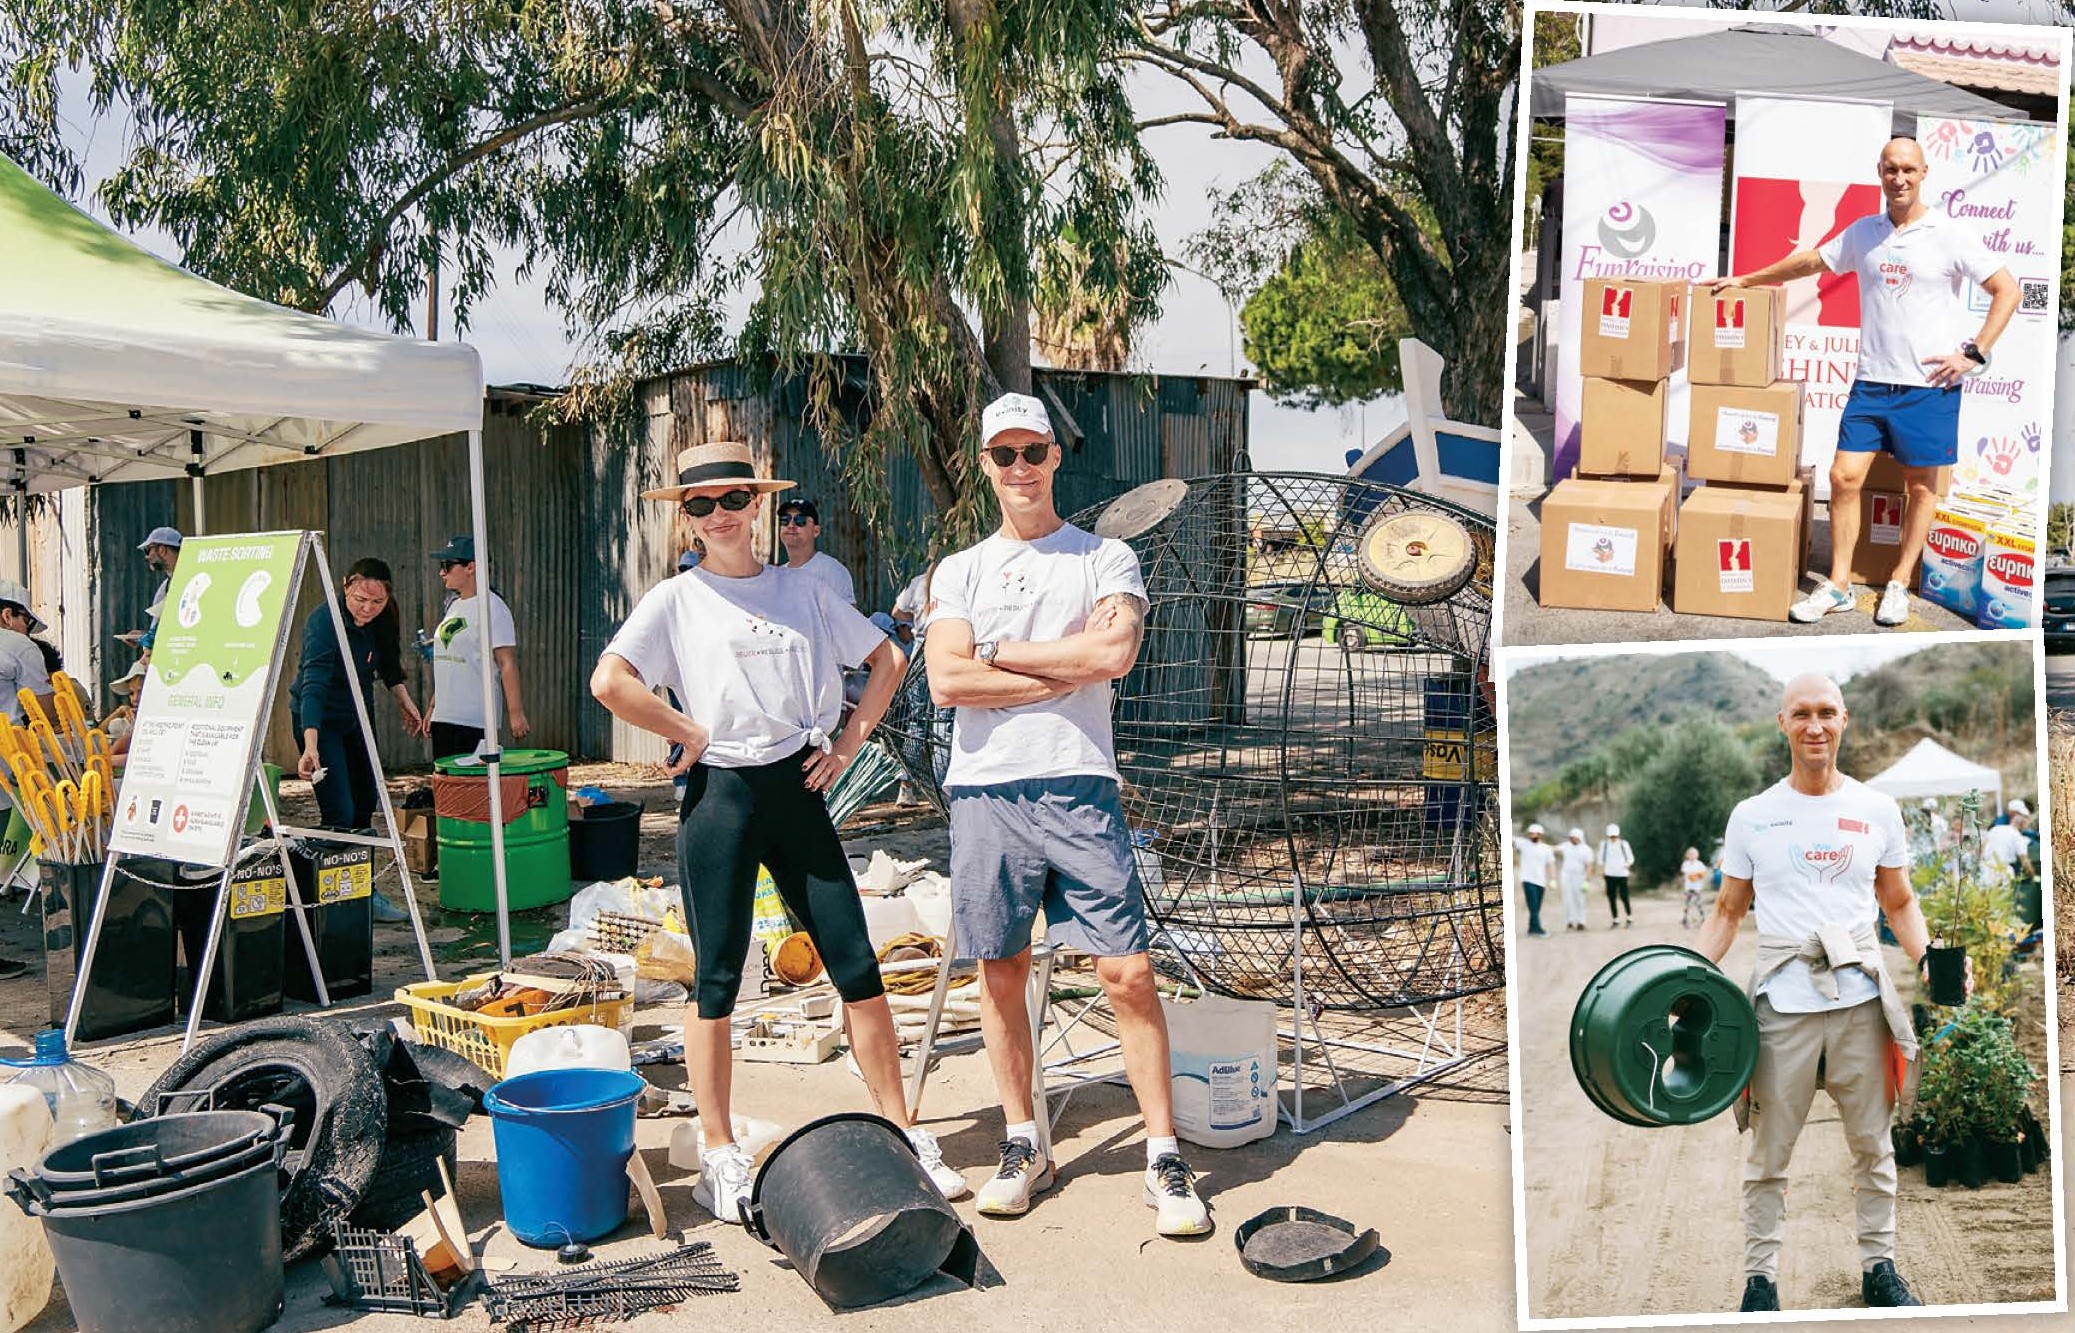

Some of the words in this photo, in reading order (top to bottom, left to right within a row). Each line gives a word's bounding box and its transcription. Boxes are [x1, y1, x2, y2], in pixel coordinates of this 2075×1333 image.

[1942, 189, 2017, 220] Connect
[1879, 263, 1908, 275] care
[1809, 340, 1819, 351] &
[1779, 358, 1857, 384] HIN'
[1928, 530, 1977, 558] ευρηκα
[1996, 535, 2017, 549] XXL
[0, 840, 18, 856] RA
[1805, 850, 1839, 861] care
[323, 850, 368, 866] NO-NO'S
[237, 863, 283, 880] NO-NO'S
